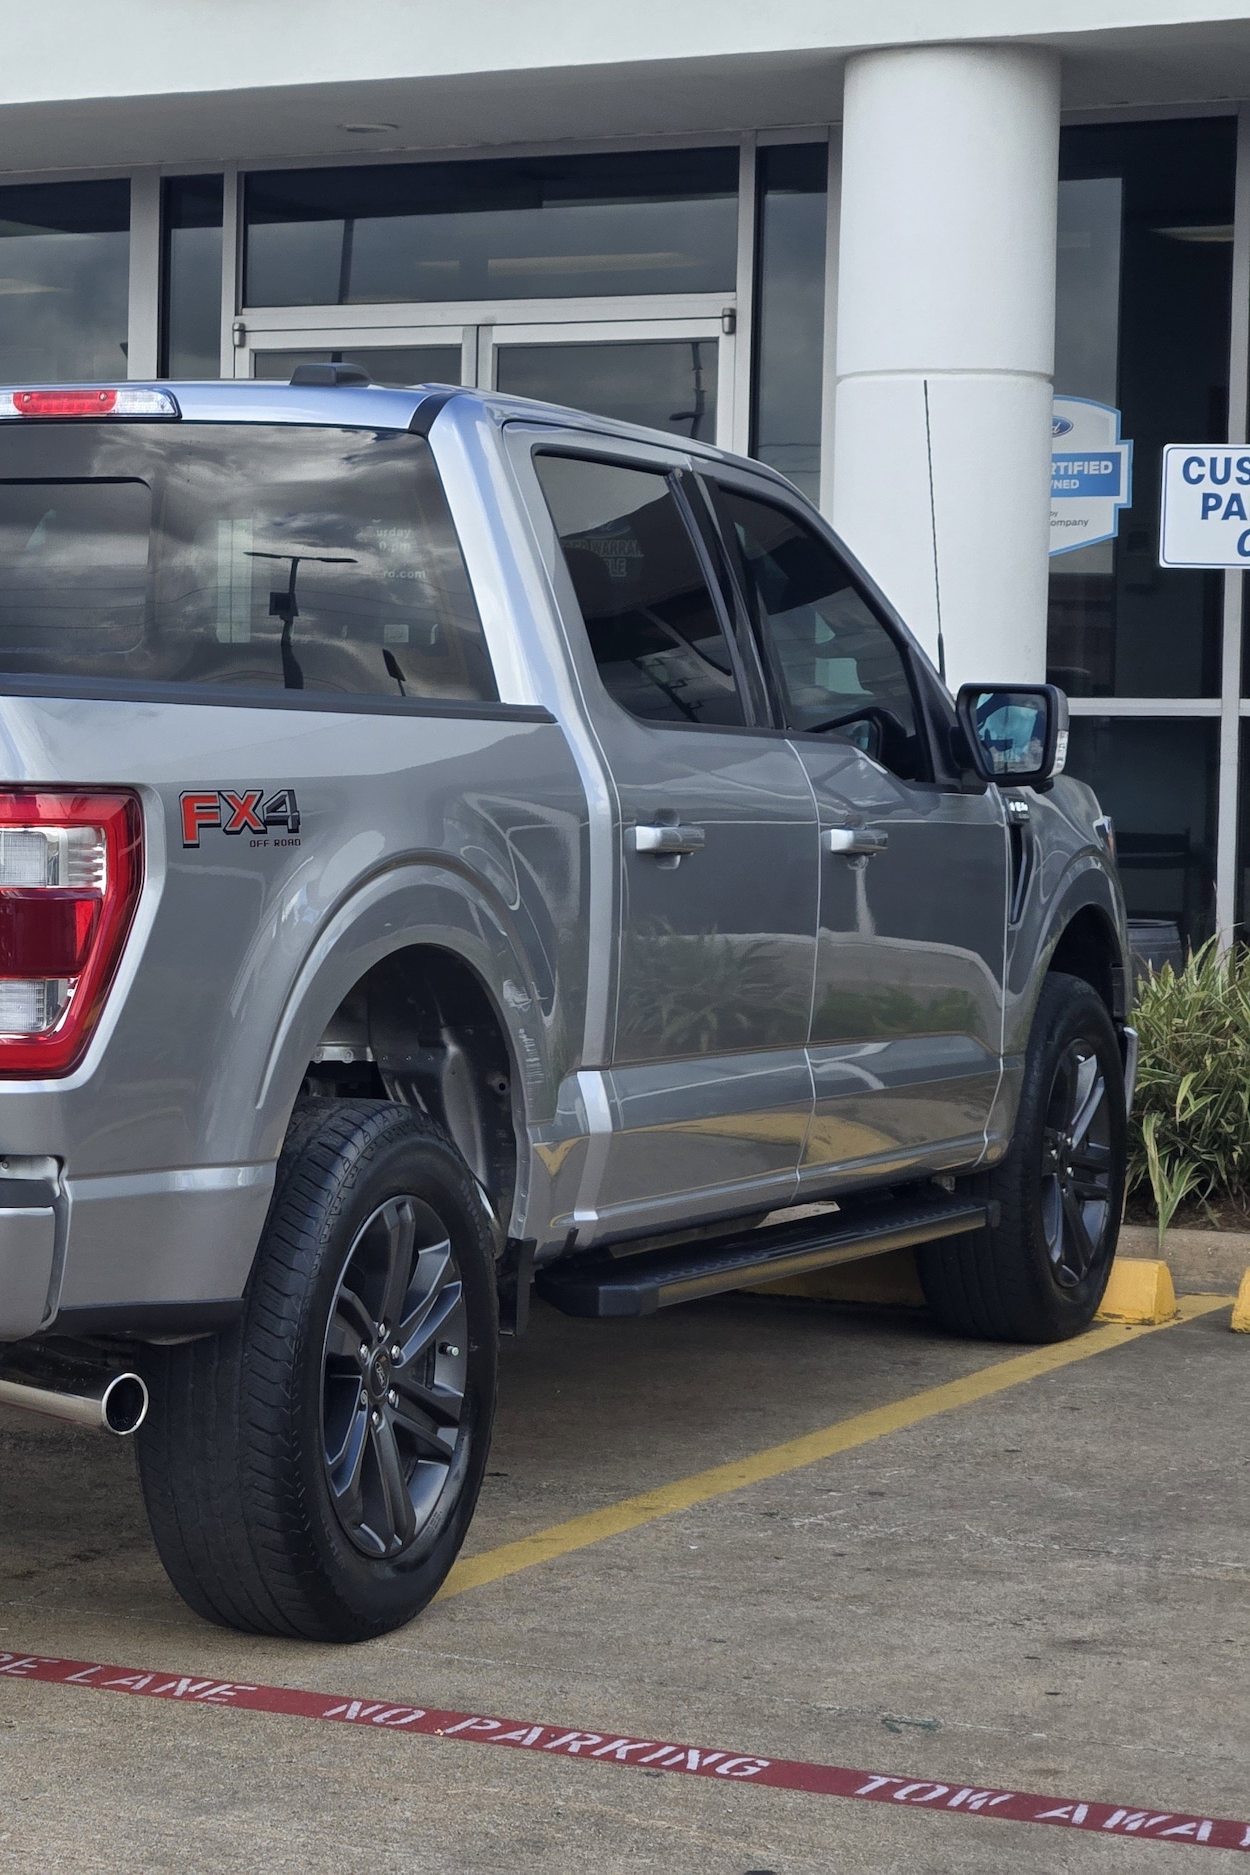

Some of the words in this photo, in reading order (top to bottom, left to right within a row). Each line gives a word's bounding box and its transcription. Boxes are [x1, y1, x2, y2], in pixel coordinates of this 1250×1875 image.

[1182, 456, 1250, 485] CUS
[1201, 492, 1249, 521] PA
[179, 789, 301, 848] FX4
[250, 839, 271, 848] OFF
[274, 838, 301, 847] ROAD
[66, 1665, 258, 1702] LANE
[322, 1700, 424, 1725] NO
[444, 1716, 771, 1777] PARKING
[854, 1775, 1015, 1811] TOW
[1034, 1803, 1250, 1847] AWA
